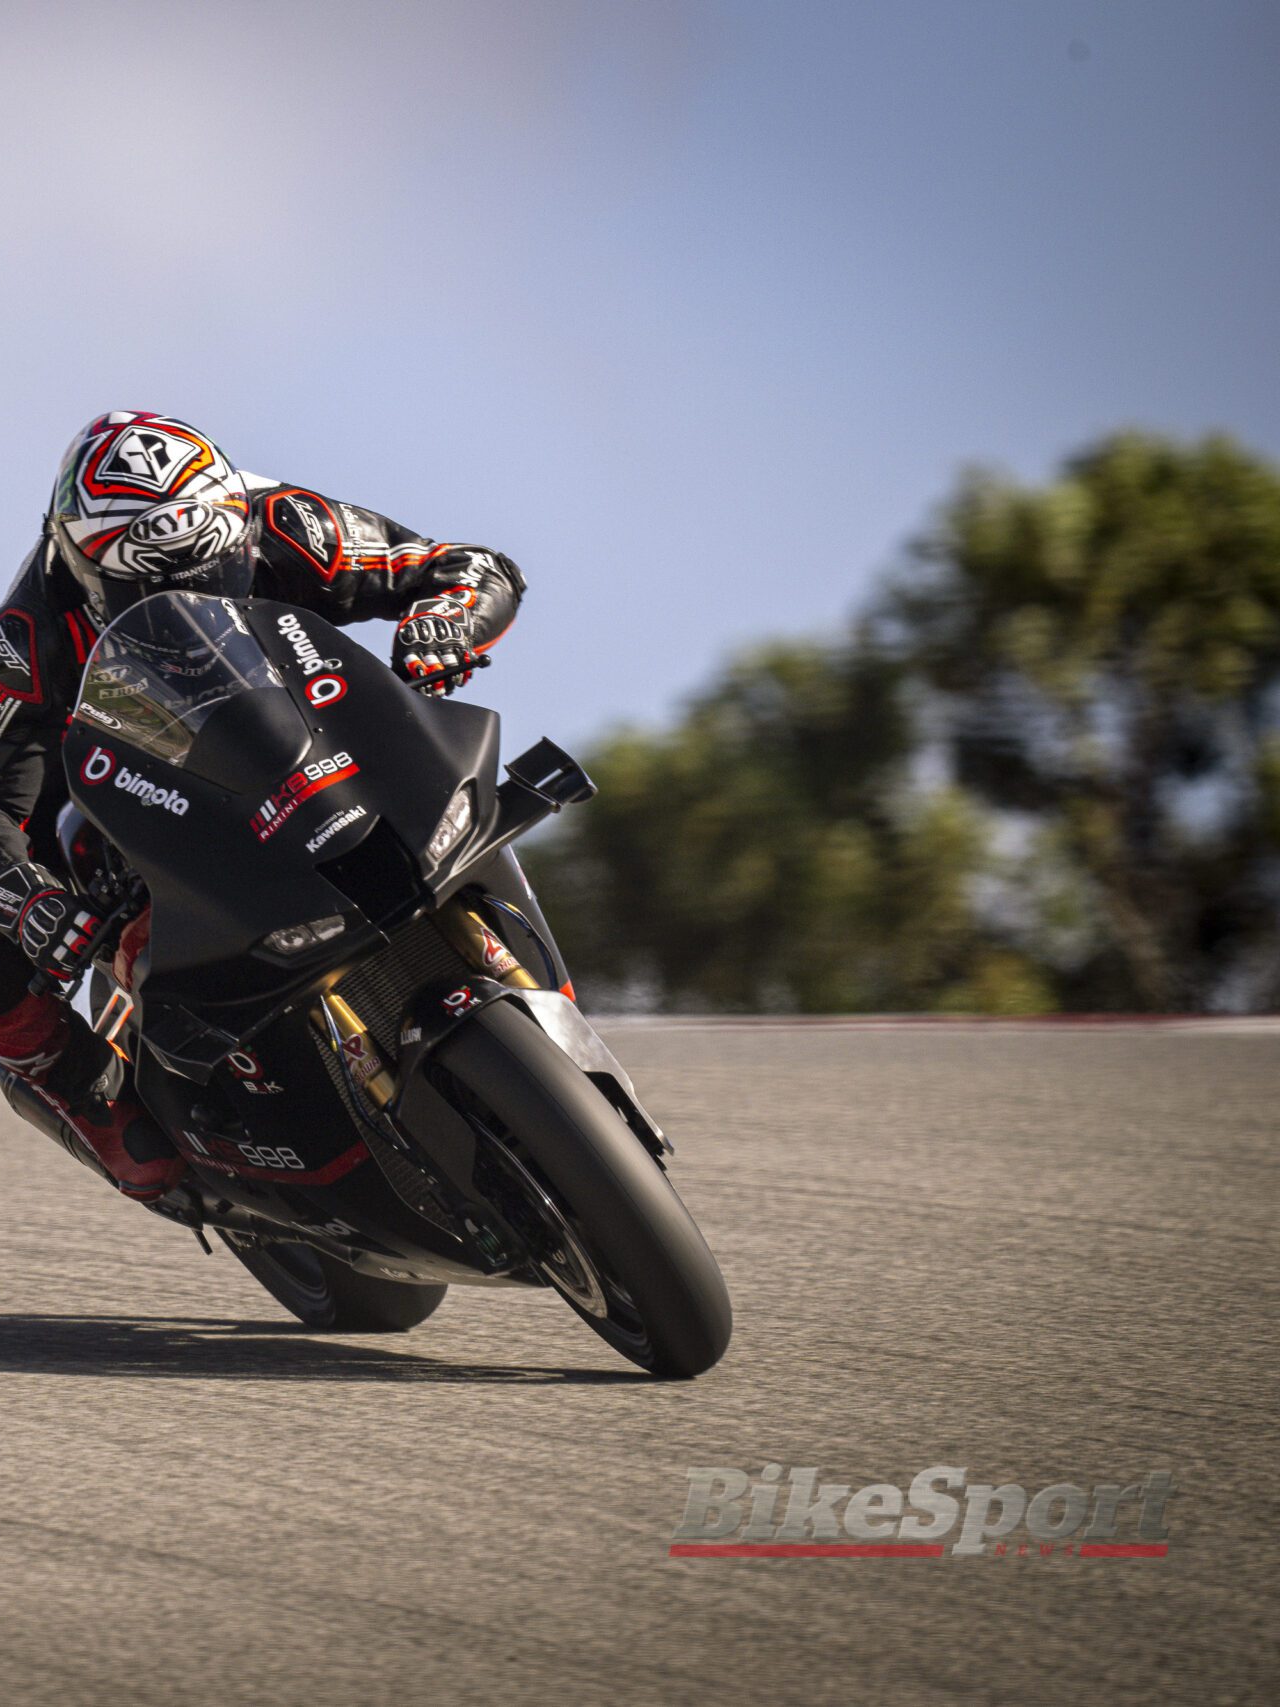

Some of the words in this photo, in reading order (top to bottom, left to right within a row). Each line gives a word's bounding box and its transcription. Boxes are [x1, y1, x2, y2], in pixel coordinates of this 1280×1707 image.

[136, 503, 198, 540] KYT
[170, 559, 219, 581] TITANTECH
[277, 613, 324, 676] bimota
[80, 702, 113, 726] Puig
[114, 767, 190, 816] bimota
[260, 799, 299, 840] RIMINI
[305, 805, 367, 853] Kawasaki
